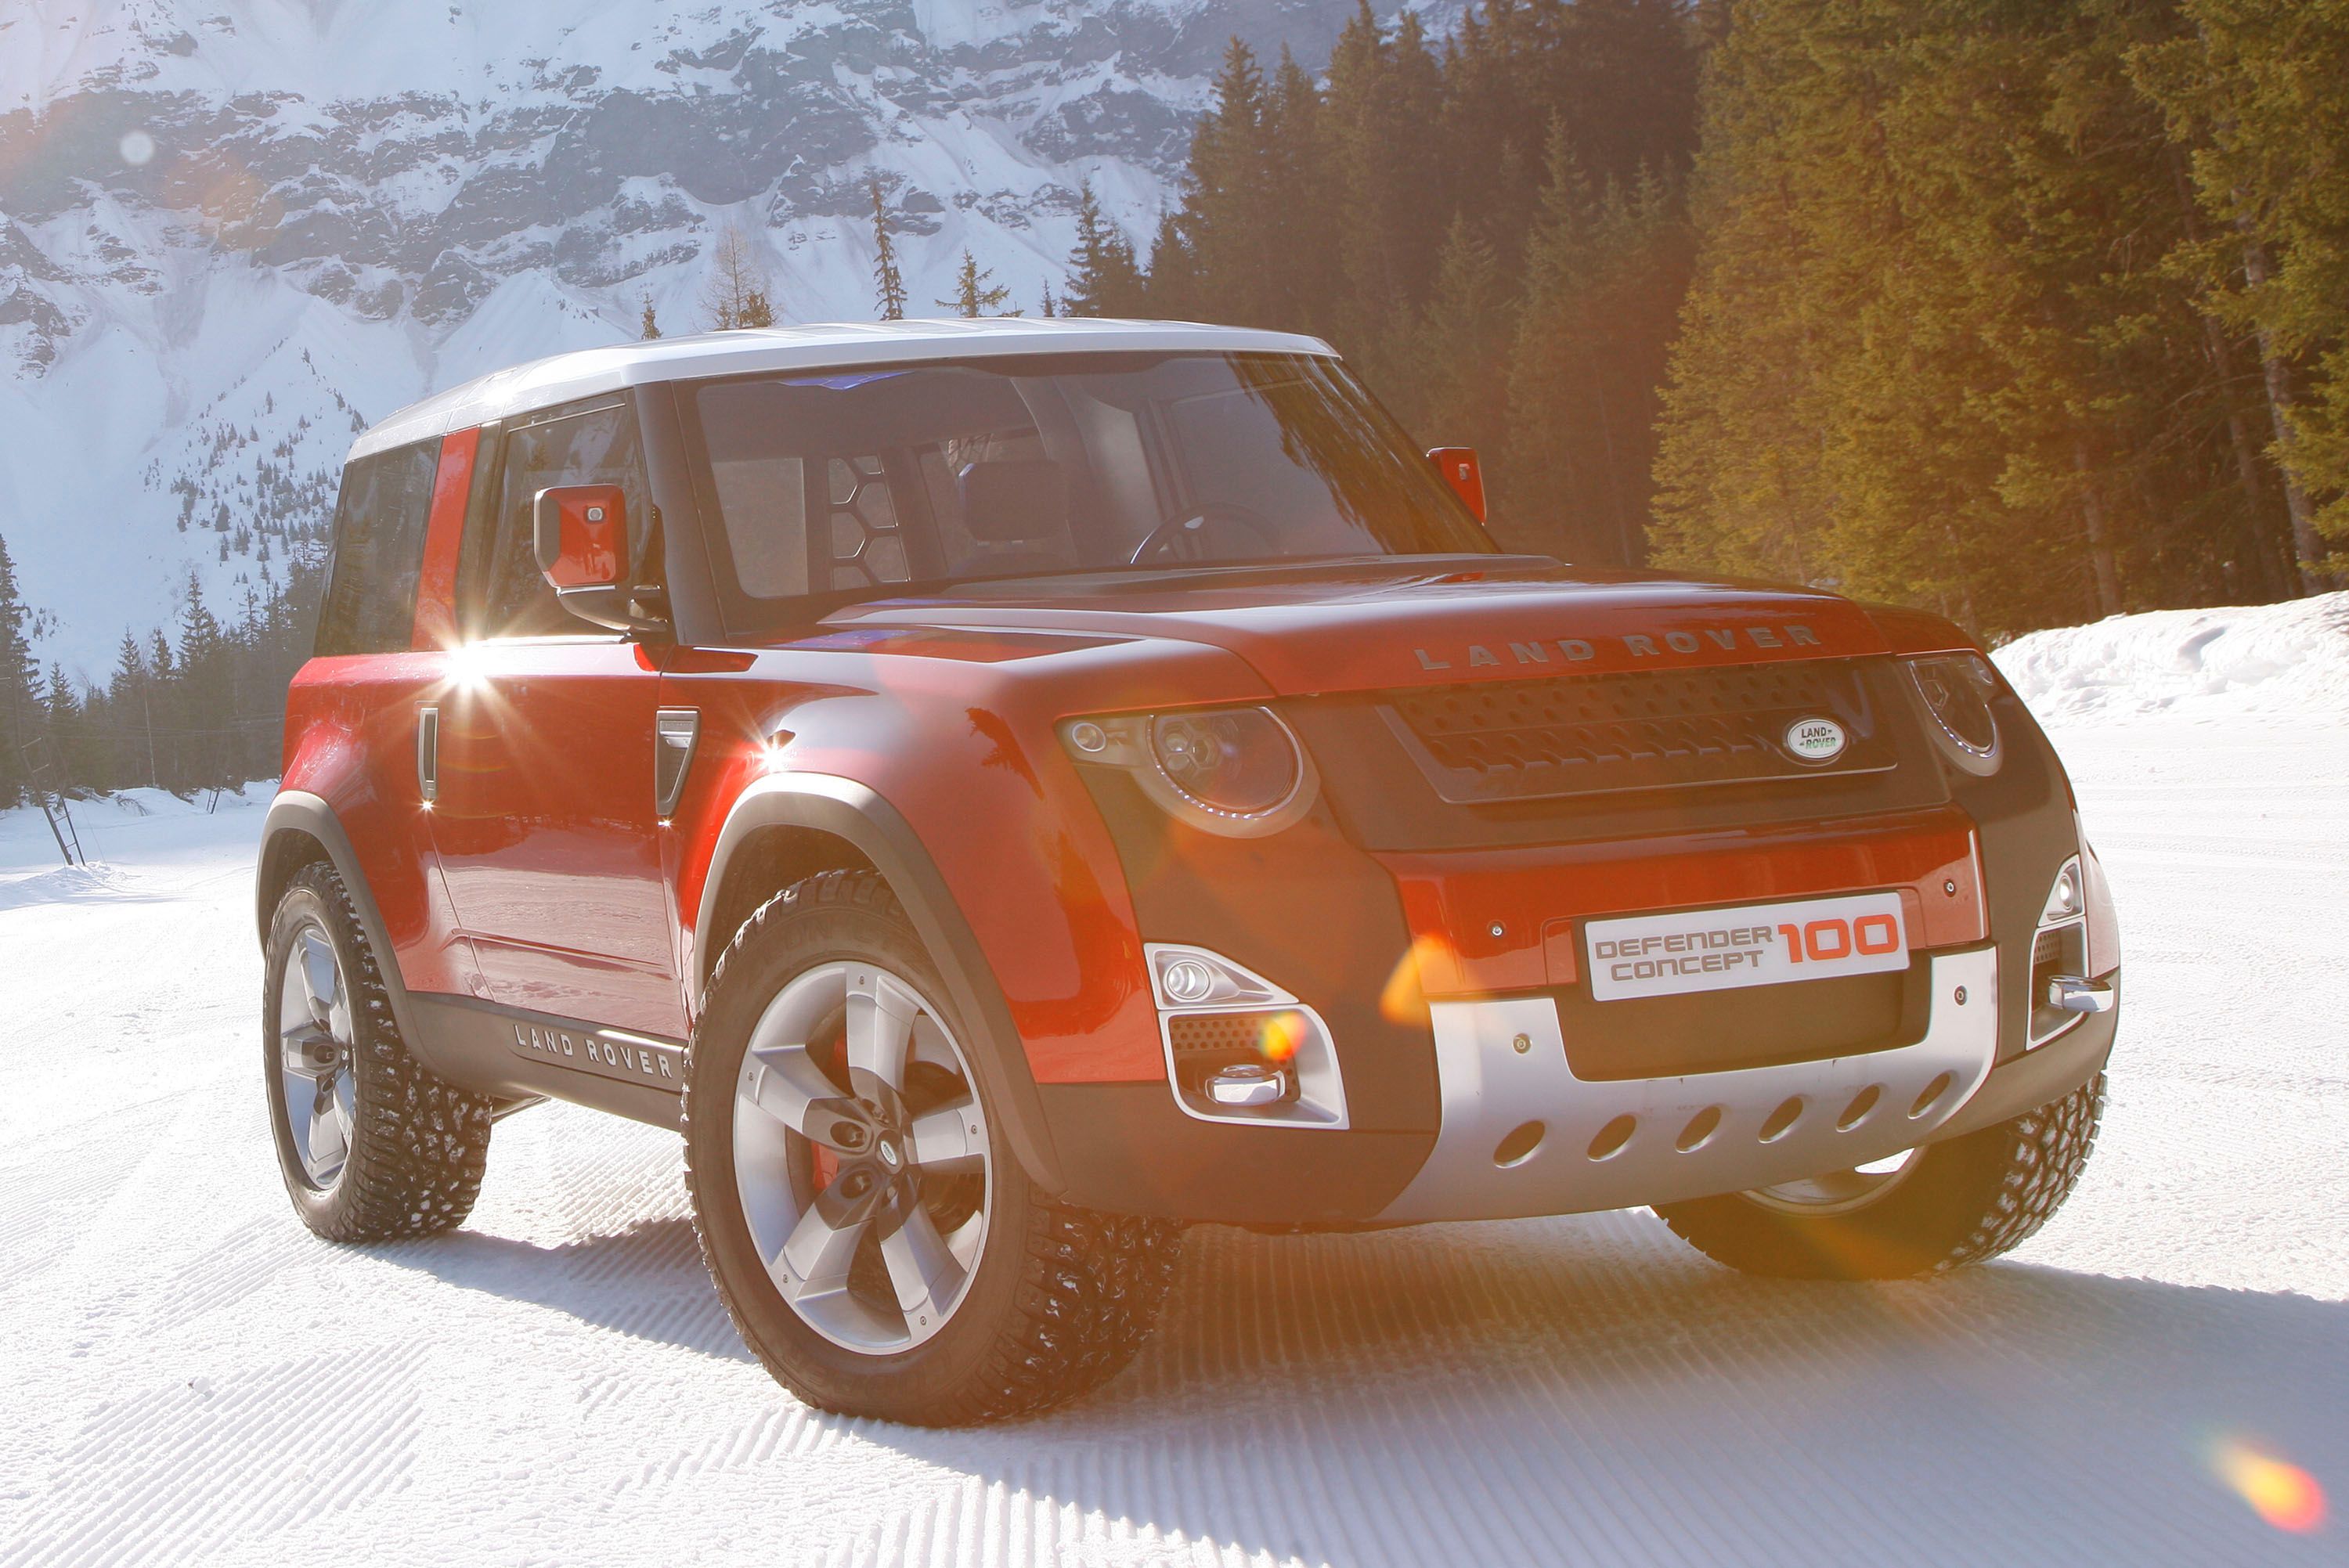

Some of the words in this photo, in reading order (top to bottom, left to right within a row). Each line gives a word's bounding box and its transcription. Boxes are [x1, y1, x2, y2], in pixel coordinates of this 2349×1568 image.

[1414, 639, 1596, 671] LAND
[1622, 624, 1822, 657] ROVER
[1594, 925, 1773, 960] DEFENDER
[1777, 913, 1900, 964] 100
[1610, 950, 1764, 982] CONCEPT
[514, 1024, 574, 1056] LAND
[585, 1039, 673, 1079] ROVER
